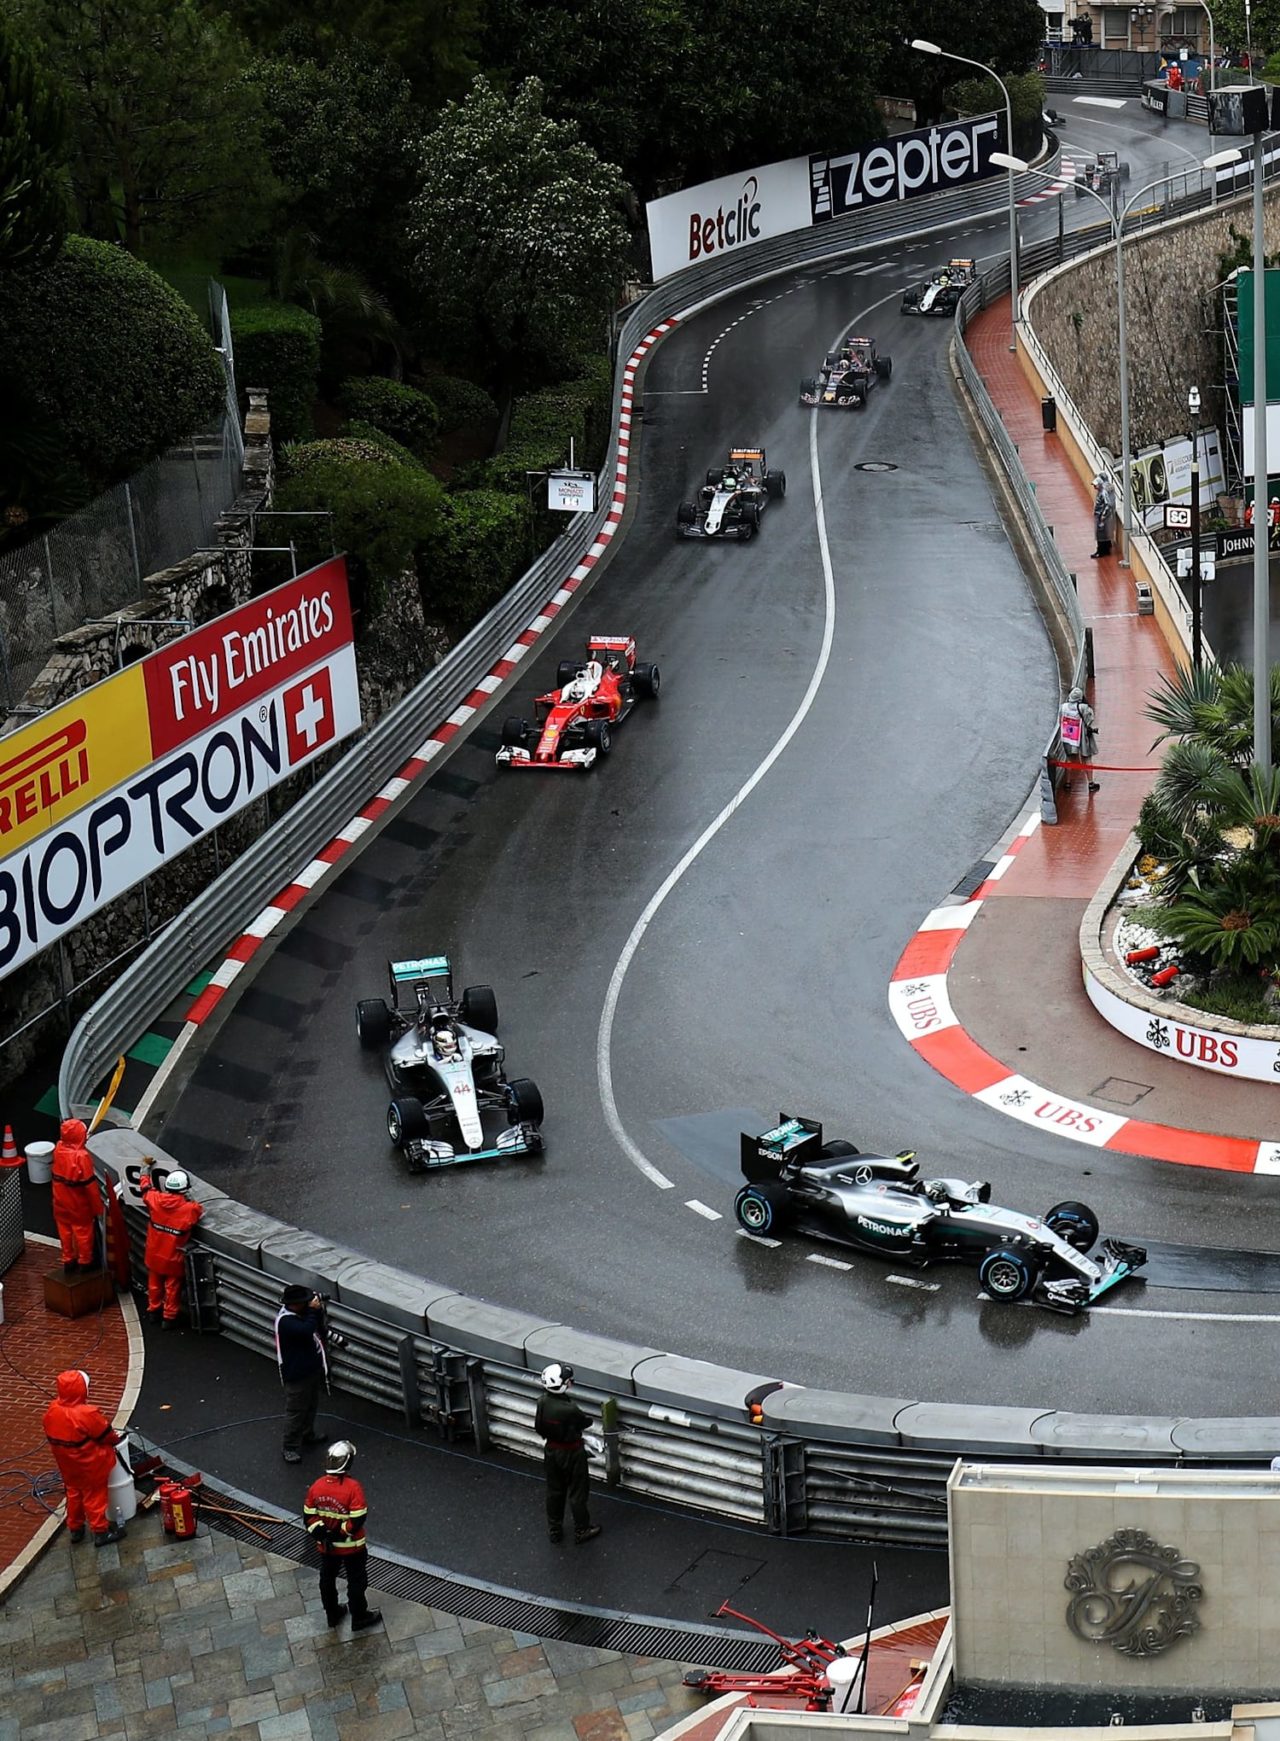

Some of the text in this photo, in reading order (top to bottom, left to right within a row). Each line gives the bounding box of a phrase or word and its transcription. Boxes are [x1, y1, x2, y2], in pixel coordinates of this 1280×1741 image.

[829, 121, 998, 206] zepter
[688, 190, 762, 261] Betclic
[1169, 510, 1188, 525] SC
[1221, 537, 1256, 557] JOHNN
[168, 590, 335, 721] Fly Emirates
[392, 956, 448, 971] PETRONAS
[907, 995, 942, 1030] UBS
[1175, 1028, 1238, 1068] UBS
[453, 1081, 472, 1095] 44
[1034, 1101, 1103, 1133] UBS
[758, 1147, 784, 1162] EPSON
[858, 1215, 911, 1238] PETRONAS
